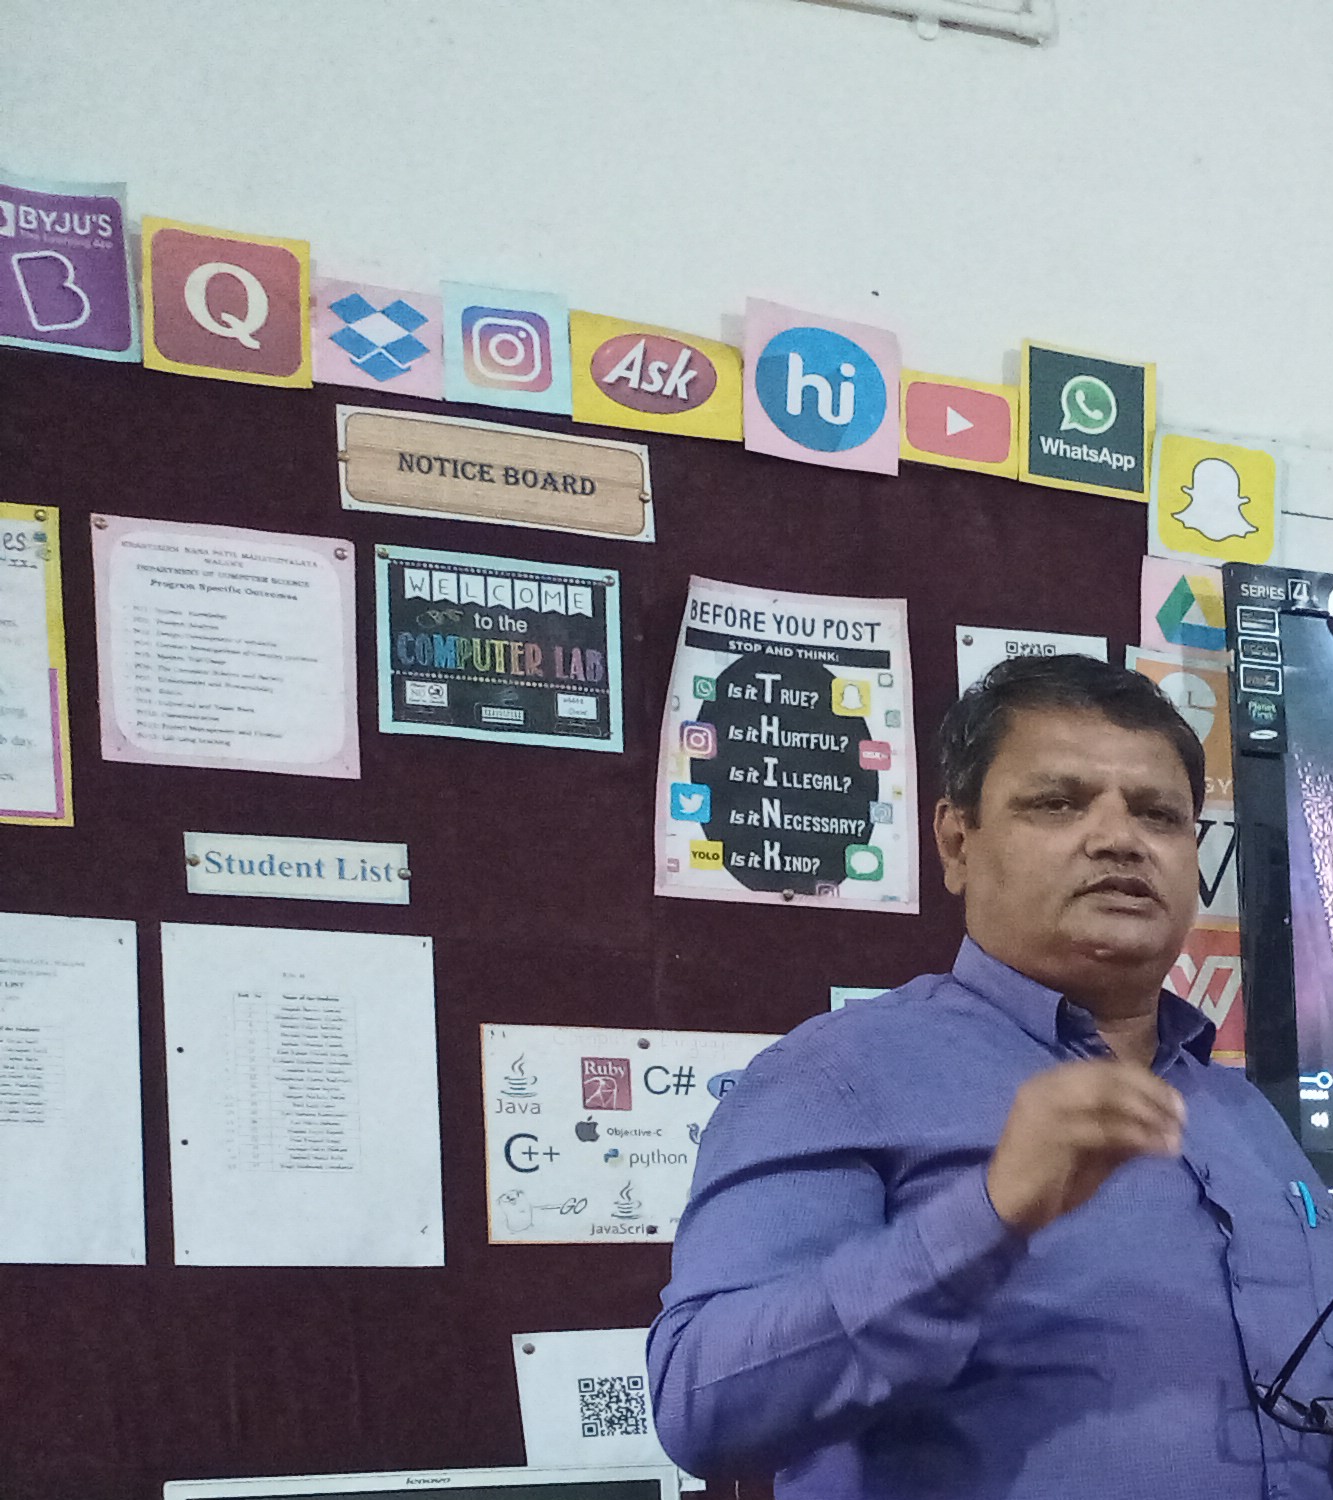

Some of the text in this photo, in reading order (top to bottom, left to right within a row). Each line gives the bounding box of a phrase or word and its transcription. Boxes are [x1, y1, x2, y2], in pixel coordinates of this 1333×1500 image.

[18, 204, 113, 238] BYJU'S
[600, 337, 699, 401] Ask
[784, 352, 857, 427] hi
[1039, 435, 1136, 473] WhatsApp
[396, 452, 597, 497] NOTICE BOARD
[408, 575, 584, 605] WELCOME
[1240, 582, 1308, 601] SERIES 4
[473, 612, 528, 633] to the
[689, 598, 882, 644] BEFORE YOU POST
[396, 631, 606, 683] COMPUTER LAB
[728, 640, 762, 653] STOP
[765, 644, 794, 658] AND
[727, 682, 743, 700] Is
[744, 684, 759, 701] it
[728, 714, 849, 752] Is it HURTFUL?
[729, 766, 745, 783] Is
[746, 767, 760, 785] it
[729, 797, 866, 838] Is it NECESSARY?
[204, 850, 395, 885] Student List
[691, 850, 721, 861] YOLO
[730, 839, 821, 875] Is it KIND?
[584, 1060, 626, 1077] Ruby
[643, 1065, 696, 1096] C#
[496, 1098, 541, 1115] Java
[606, 1127, 662, 1137] Objective-C
[504, 1133, 560, 1173] C++
[629, 1148, 688, 1168] python
[560, 1198, 588, 1215] GO
